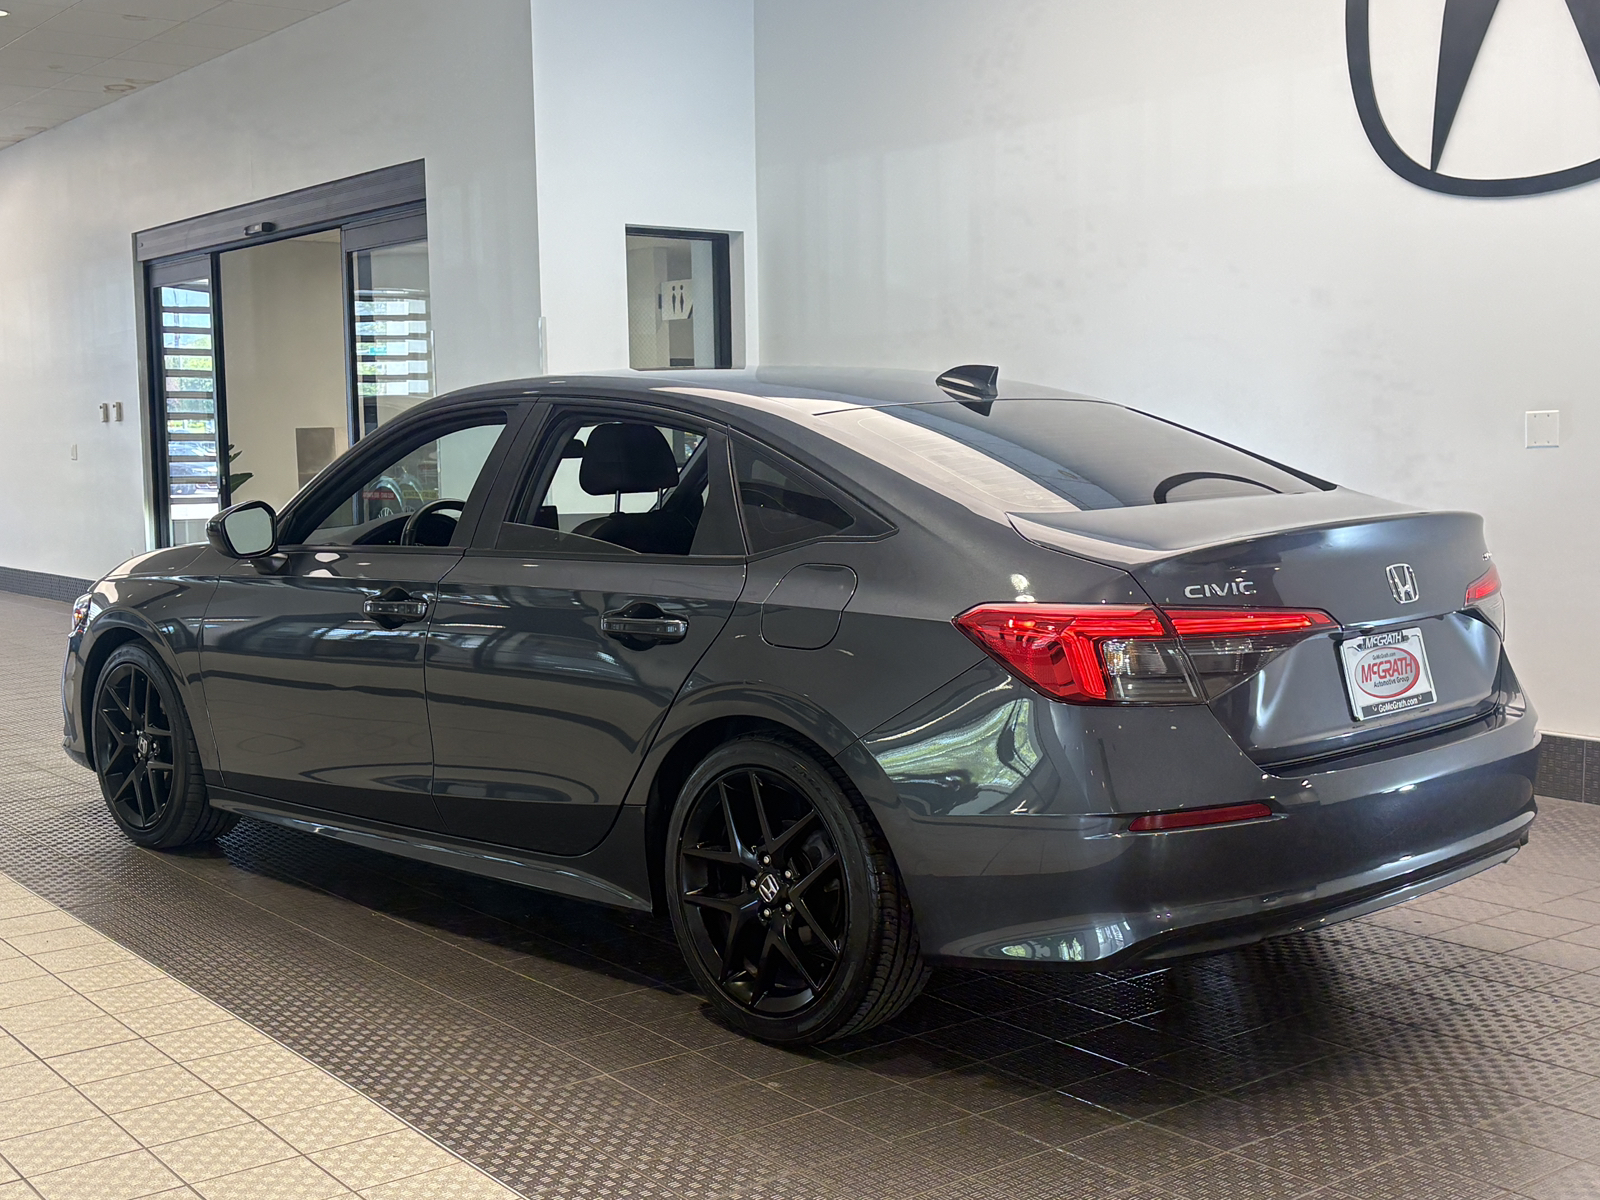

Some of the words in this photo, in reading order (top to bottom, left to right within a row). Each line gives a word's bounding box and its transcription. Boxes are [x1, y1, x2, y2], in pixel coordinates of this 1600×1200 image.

[1184, 581, 1256, 598] CIVIC
[1374, 678, 1396, 688] Automotive
[1396, 676, 1410, 685] Group
[1378, 697, 1418, 712] GoMcGrath.com
